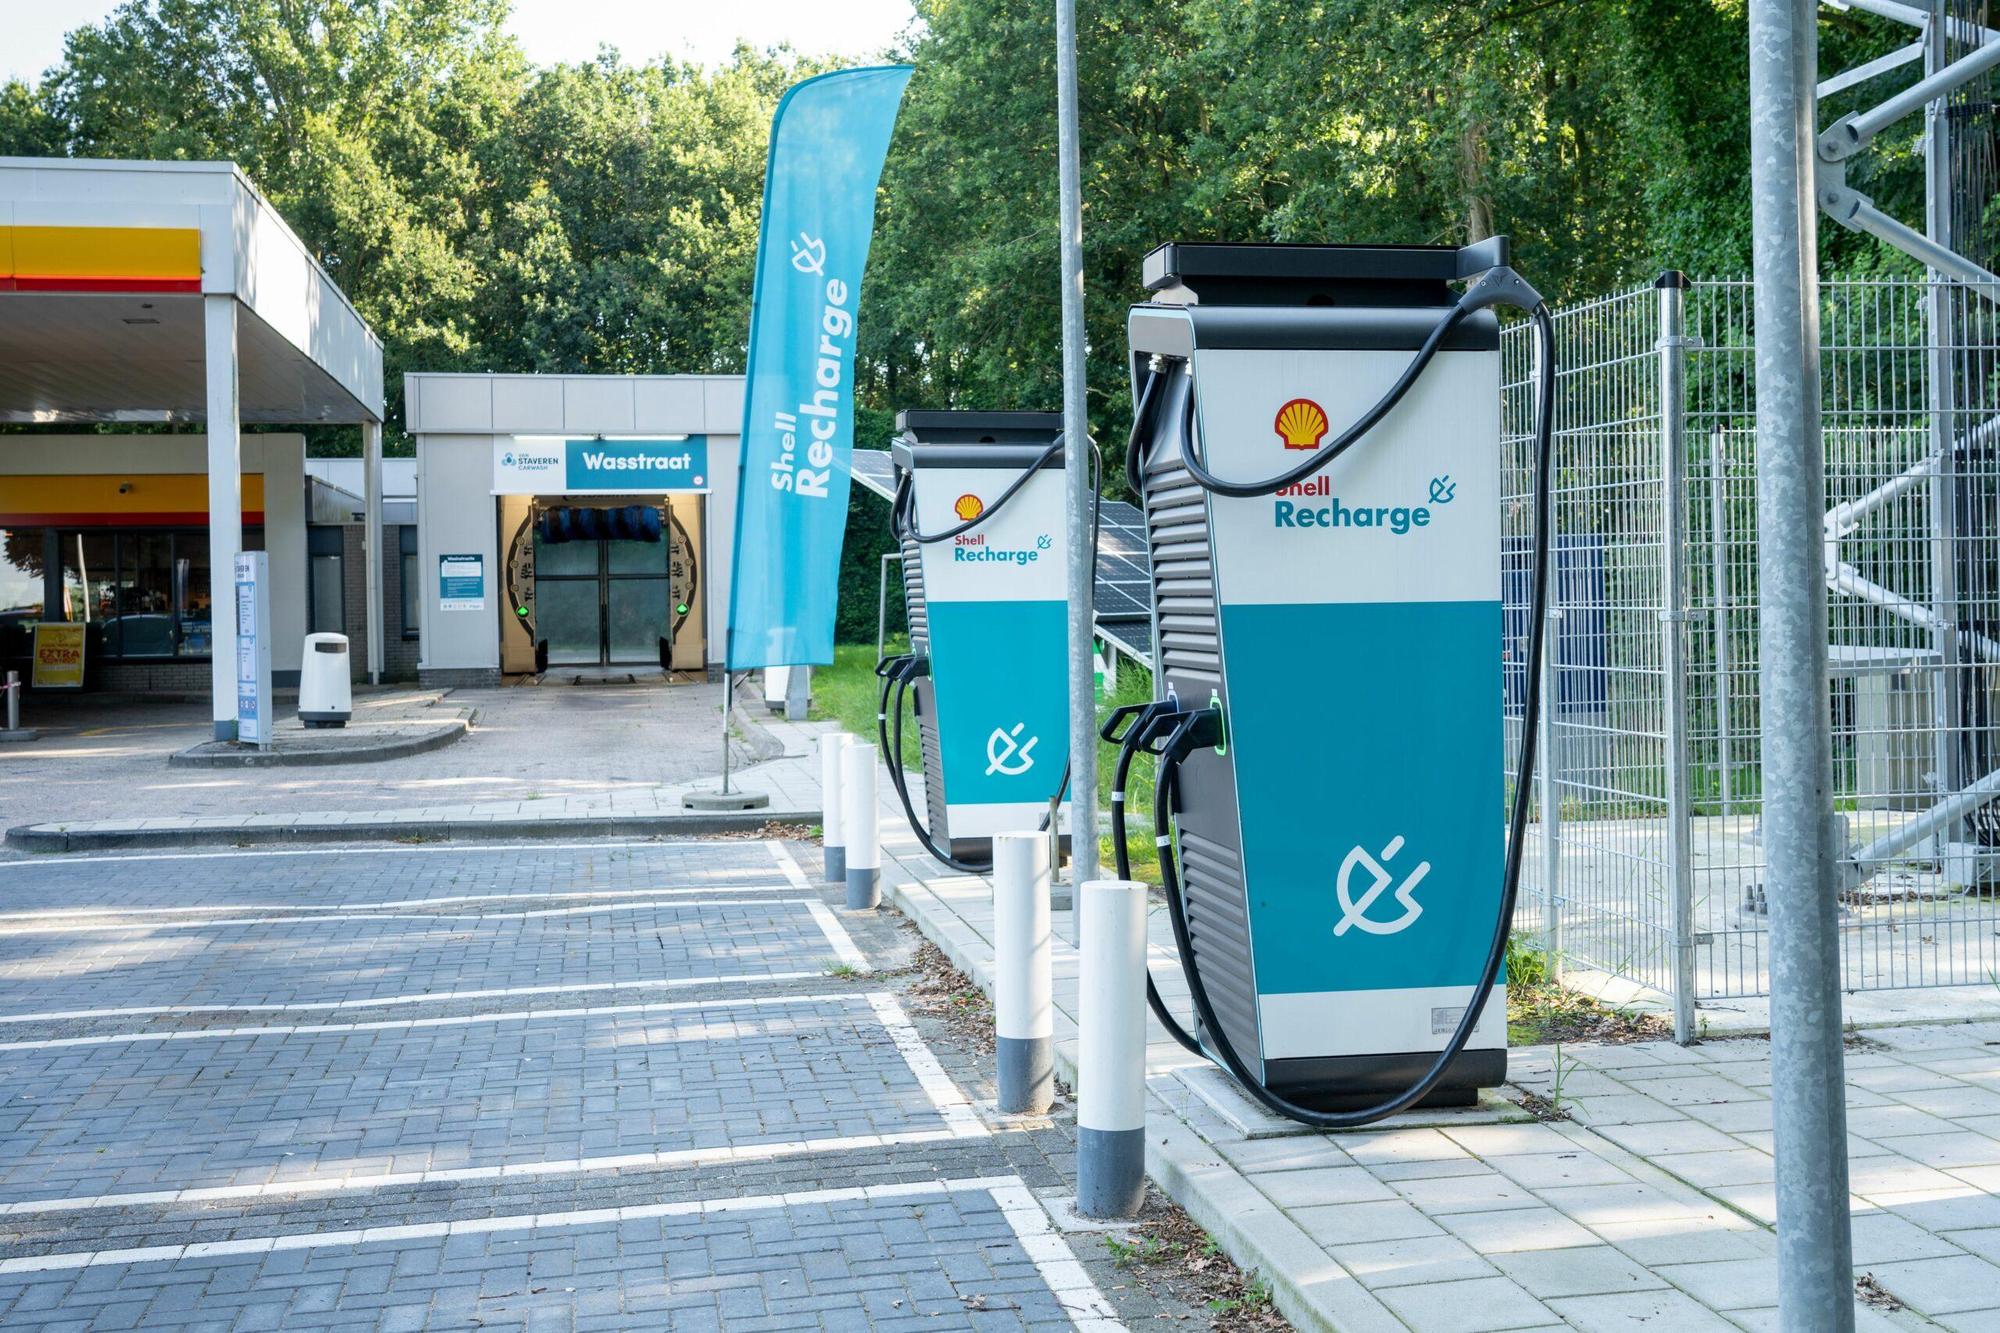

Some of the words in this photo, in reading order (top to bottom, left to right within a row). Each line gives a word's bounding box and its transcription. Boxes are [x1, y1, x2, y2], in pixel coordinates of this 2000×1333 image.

[795, 278, 852, 498] Recharge
[518, 457, 559, 465] STAVEREN
[582, 452, 691, 470] Wasstraat
[771, 412, 797, 492] Shell
[1275, 498, 1430, 535] Recharge
[955, 534, 985, 546] Shell
[954, 546, 1038, 565] Recharge
